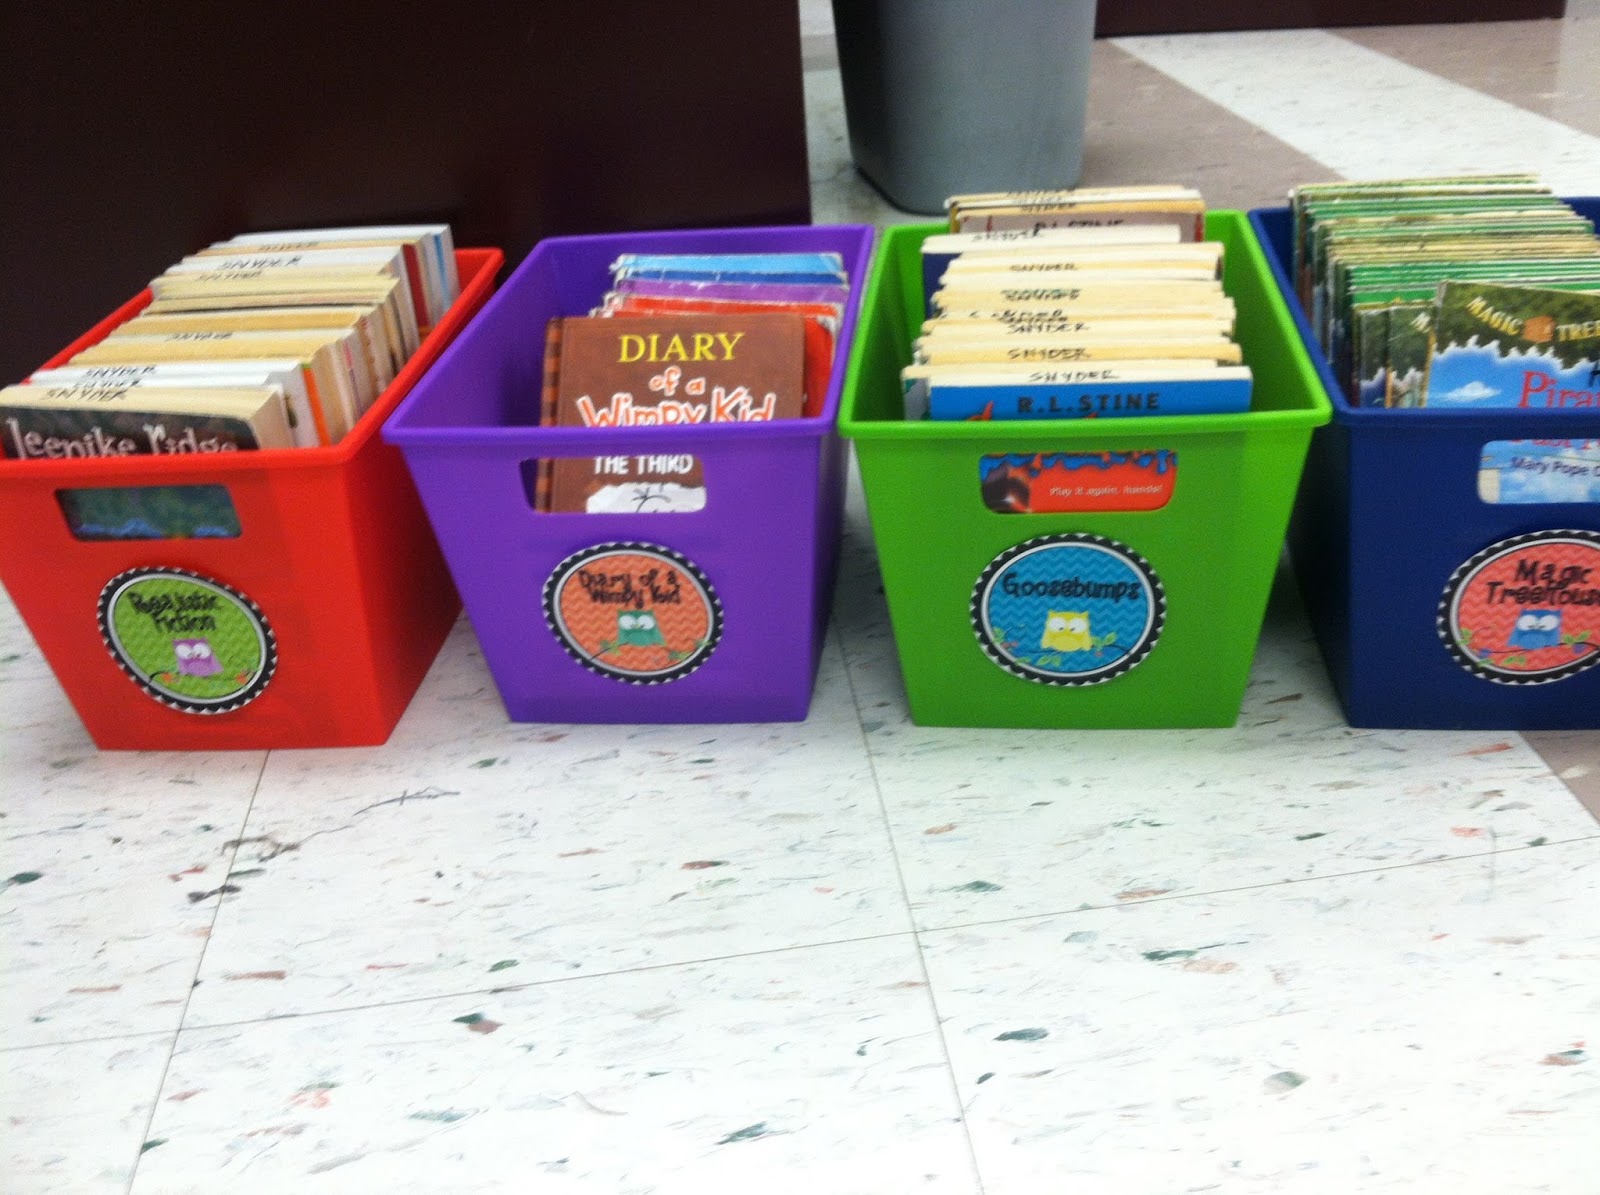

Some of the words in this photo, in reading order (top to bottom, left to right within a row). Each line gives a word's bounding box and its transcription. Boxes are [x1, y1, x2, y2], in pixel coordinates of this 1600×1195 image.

[1466, 296, 1523, 336] MAGIC
[616, 332, 745, 363] DIARY
[1006, 347, 1092, 361] SNYDER
[648, 365, 682, 396] of
[685, 377, 706, 396] a
[1028, 370, 1120, 383] SNYDER
[711, 386, 776, 423] Kid
[594, 455, 629, 475] THE
[637, 453, 694, 475] THIRD
[1511, 457, 1548, 475] Mary
[1553, 461, 1589, 477] Pope
[1049, 486, 1073, 497] Play
[579, 570, 631, 594] Diary
[639, 568, 658, 587] of
[667, 570, 676, 585] a
[1002, 572, 1142, 603] Goosebumps
[1514, 559, 1592, 590] Magic
[651, 583, 681, 604] Kid
